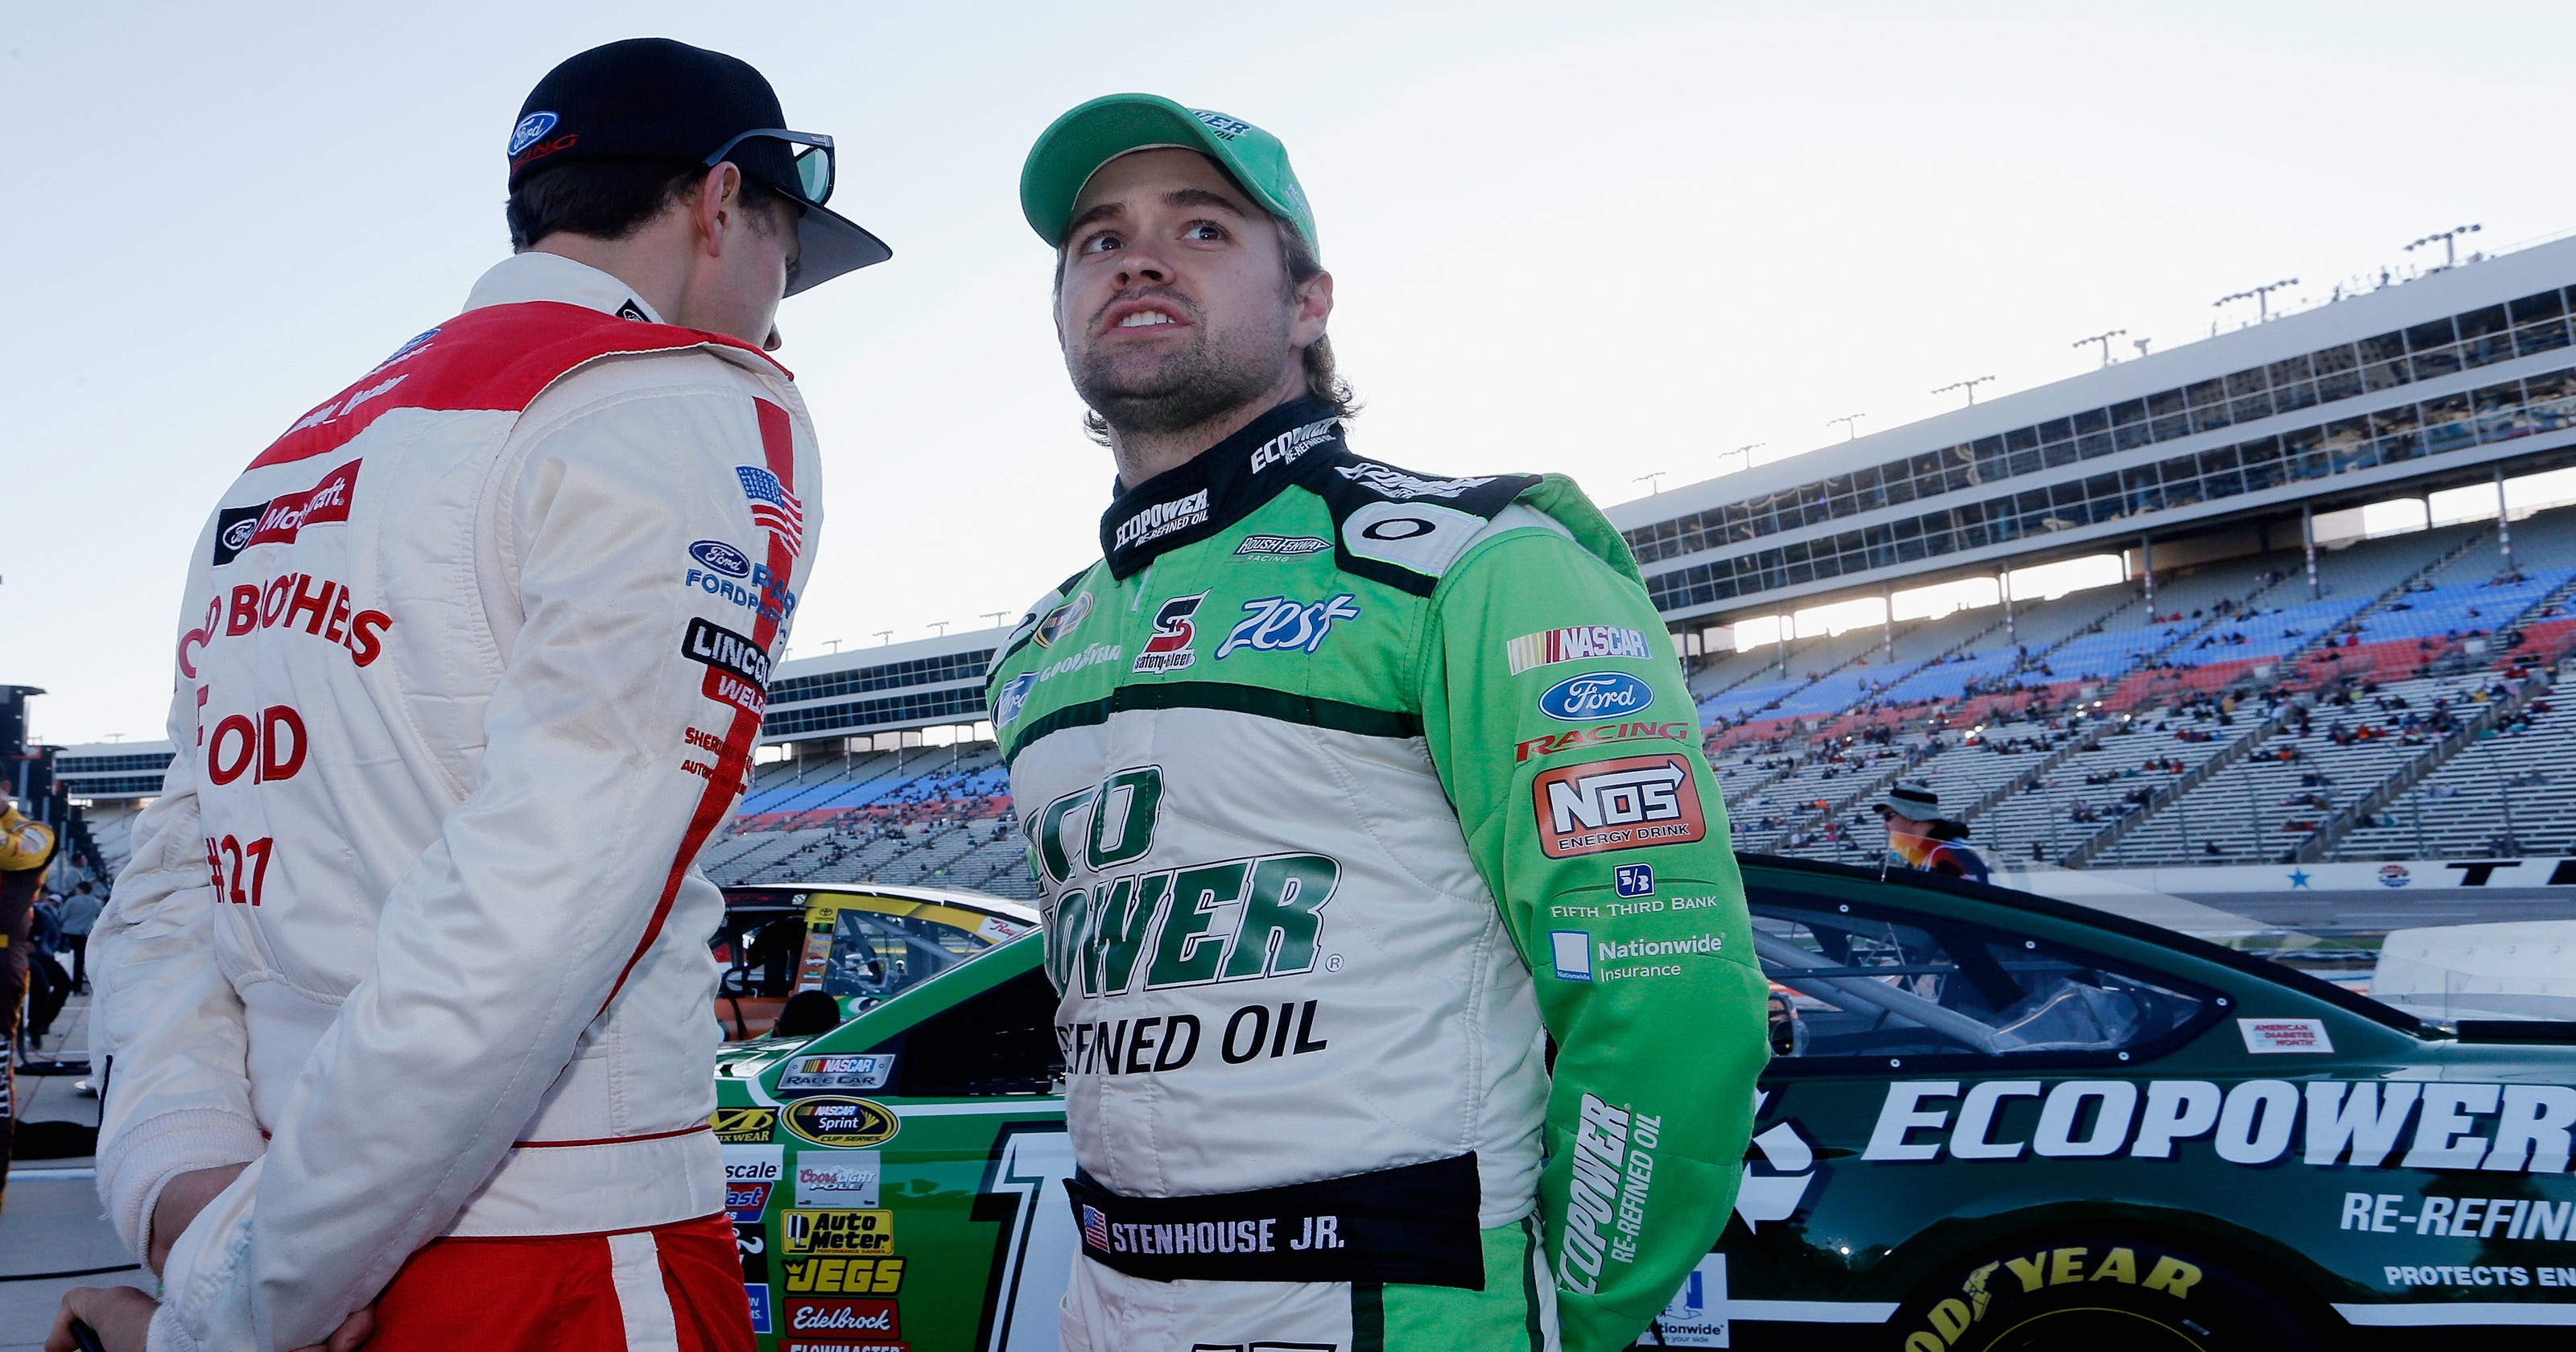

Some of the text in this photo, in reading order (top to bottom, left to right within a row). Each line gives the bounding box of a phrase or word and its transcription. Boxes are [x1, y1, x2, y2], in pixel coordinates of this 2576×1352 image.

[1113, 488, 1209, 552] ECOPOWER
[1191, 509, 1209, 526] OIL
[704, 546, 741, 571] Ford
[1247, 554, 1290, 563] RACING
[1559, 627, 1645, 661] NASCAR
[1563, 678, 1637, 714] Ford
[1514, 722, 1689, 763] RACING
[1547, 761, 1684, 834] NOS
[1558, 823, 1691, 851] ENERGY DRINK
[1550, 895, 1718, 918] FIFTH THIRD BANK
[1598, 933, 1722, 962] Nationwide
[1557, 971, 1591, 981] Nationwide
[1600, 964, 1682, 983] Insurance
[1221, 1000, 1329, 1065] OIL
[823, 1058, 873, 1073] NASCAR
[786, 1076, 875, 1085] RACE CAR
[814, 1106, 856, 1116] NASCAR
[818, 1117, 859, 1131] Sprint
[1860, 1080, 2576, 1174] ECOPOWER
[733, 1131, 770, 1142] WEAR
[725, 1161, 777, 1178] scale
[799, 1169, 838, 1184] Coors
[809, 1182, 864, 1191] POLE
[1611, 1113, 1662, 1263] RE-REFINED OIL
[813, 1213, 877, 1231] Auto
[809, 1230, 890, 1250] Meter
[1113, 1215, 1346, 1254] STENHOUSE JR.
[786, 1259, 904, 1292] JEGS
[2383, 1266, 2529, 1287] PROTECTS
[793, 1305, 891, 1331] Edelbrock
